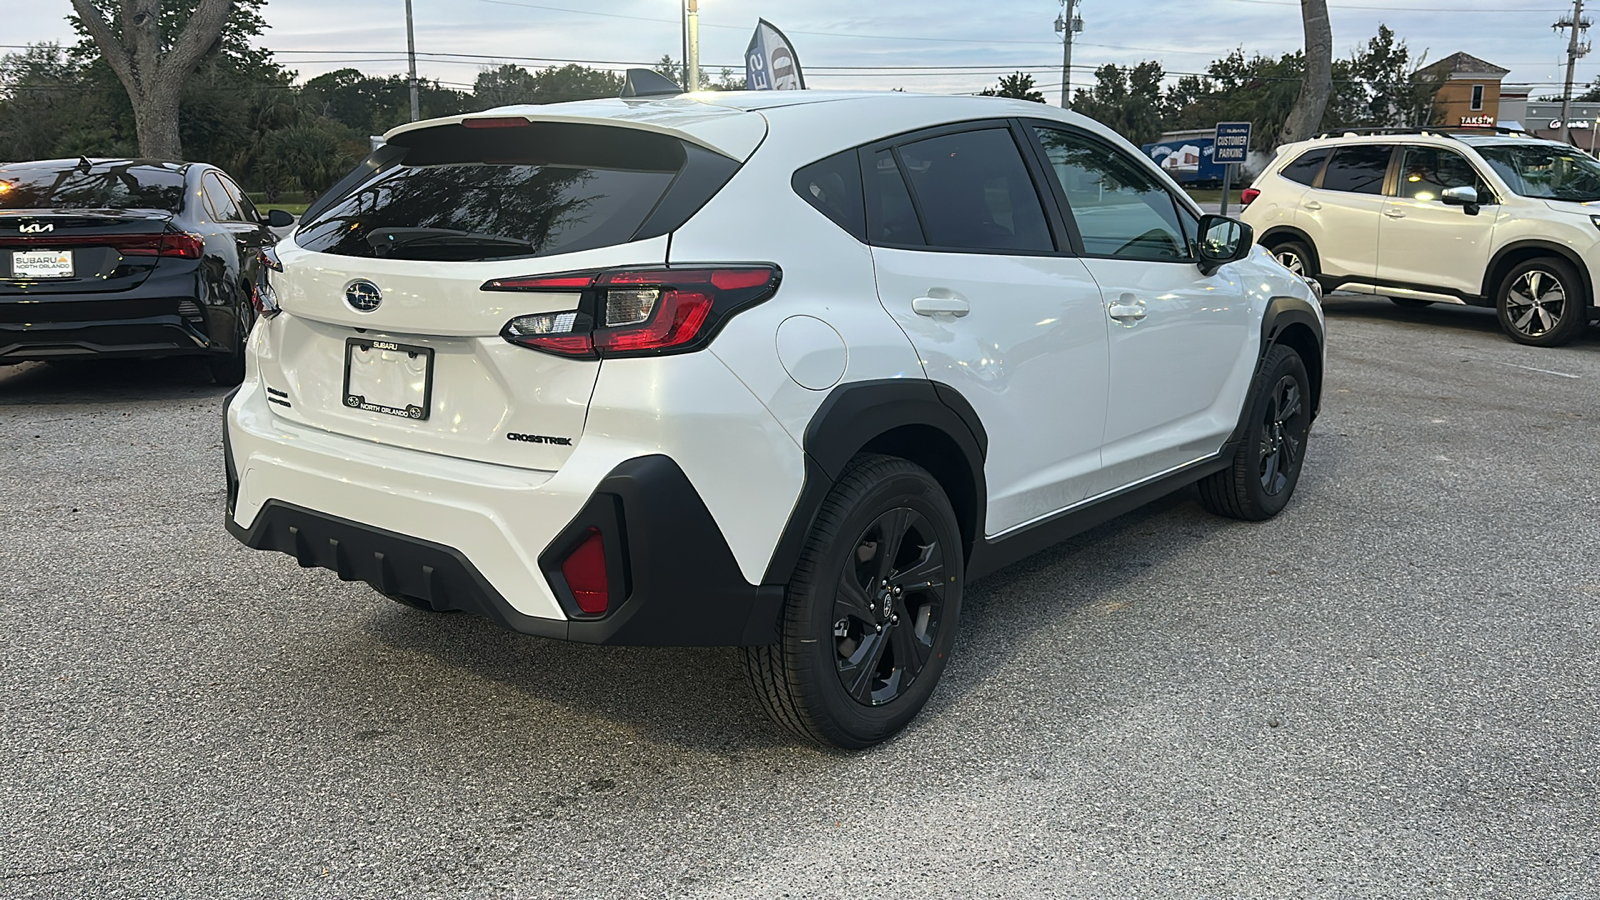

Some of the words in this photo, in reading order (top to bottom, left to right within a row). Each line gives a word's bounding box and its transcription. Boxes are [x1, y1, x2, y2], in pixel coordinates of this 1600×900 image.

[1217, 136, 1247, 146] CUSTOMER
[1218, 148, 1243, 158] PARKING
[373, 341, 398, 350] SUBARU
[360, 403, 380, 412] NORTH
[380, 407, 409, 417] ORLANDO
[506, 432, 573, 446] CROSSTREK
